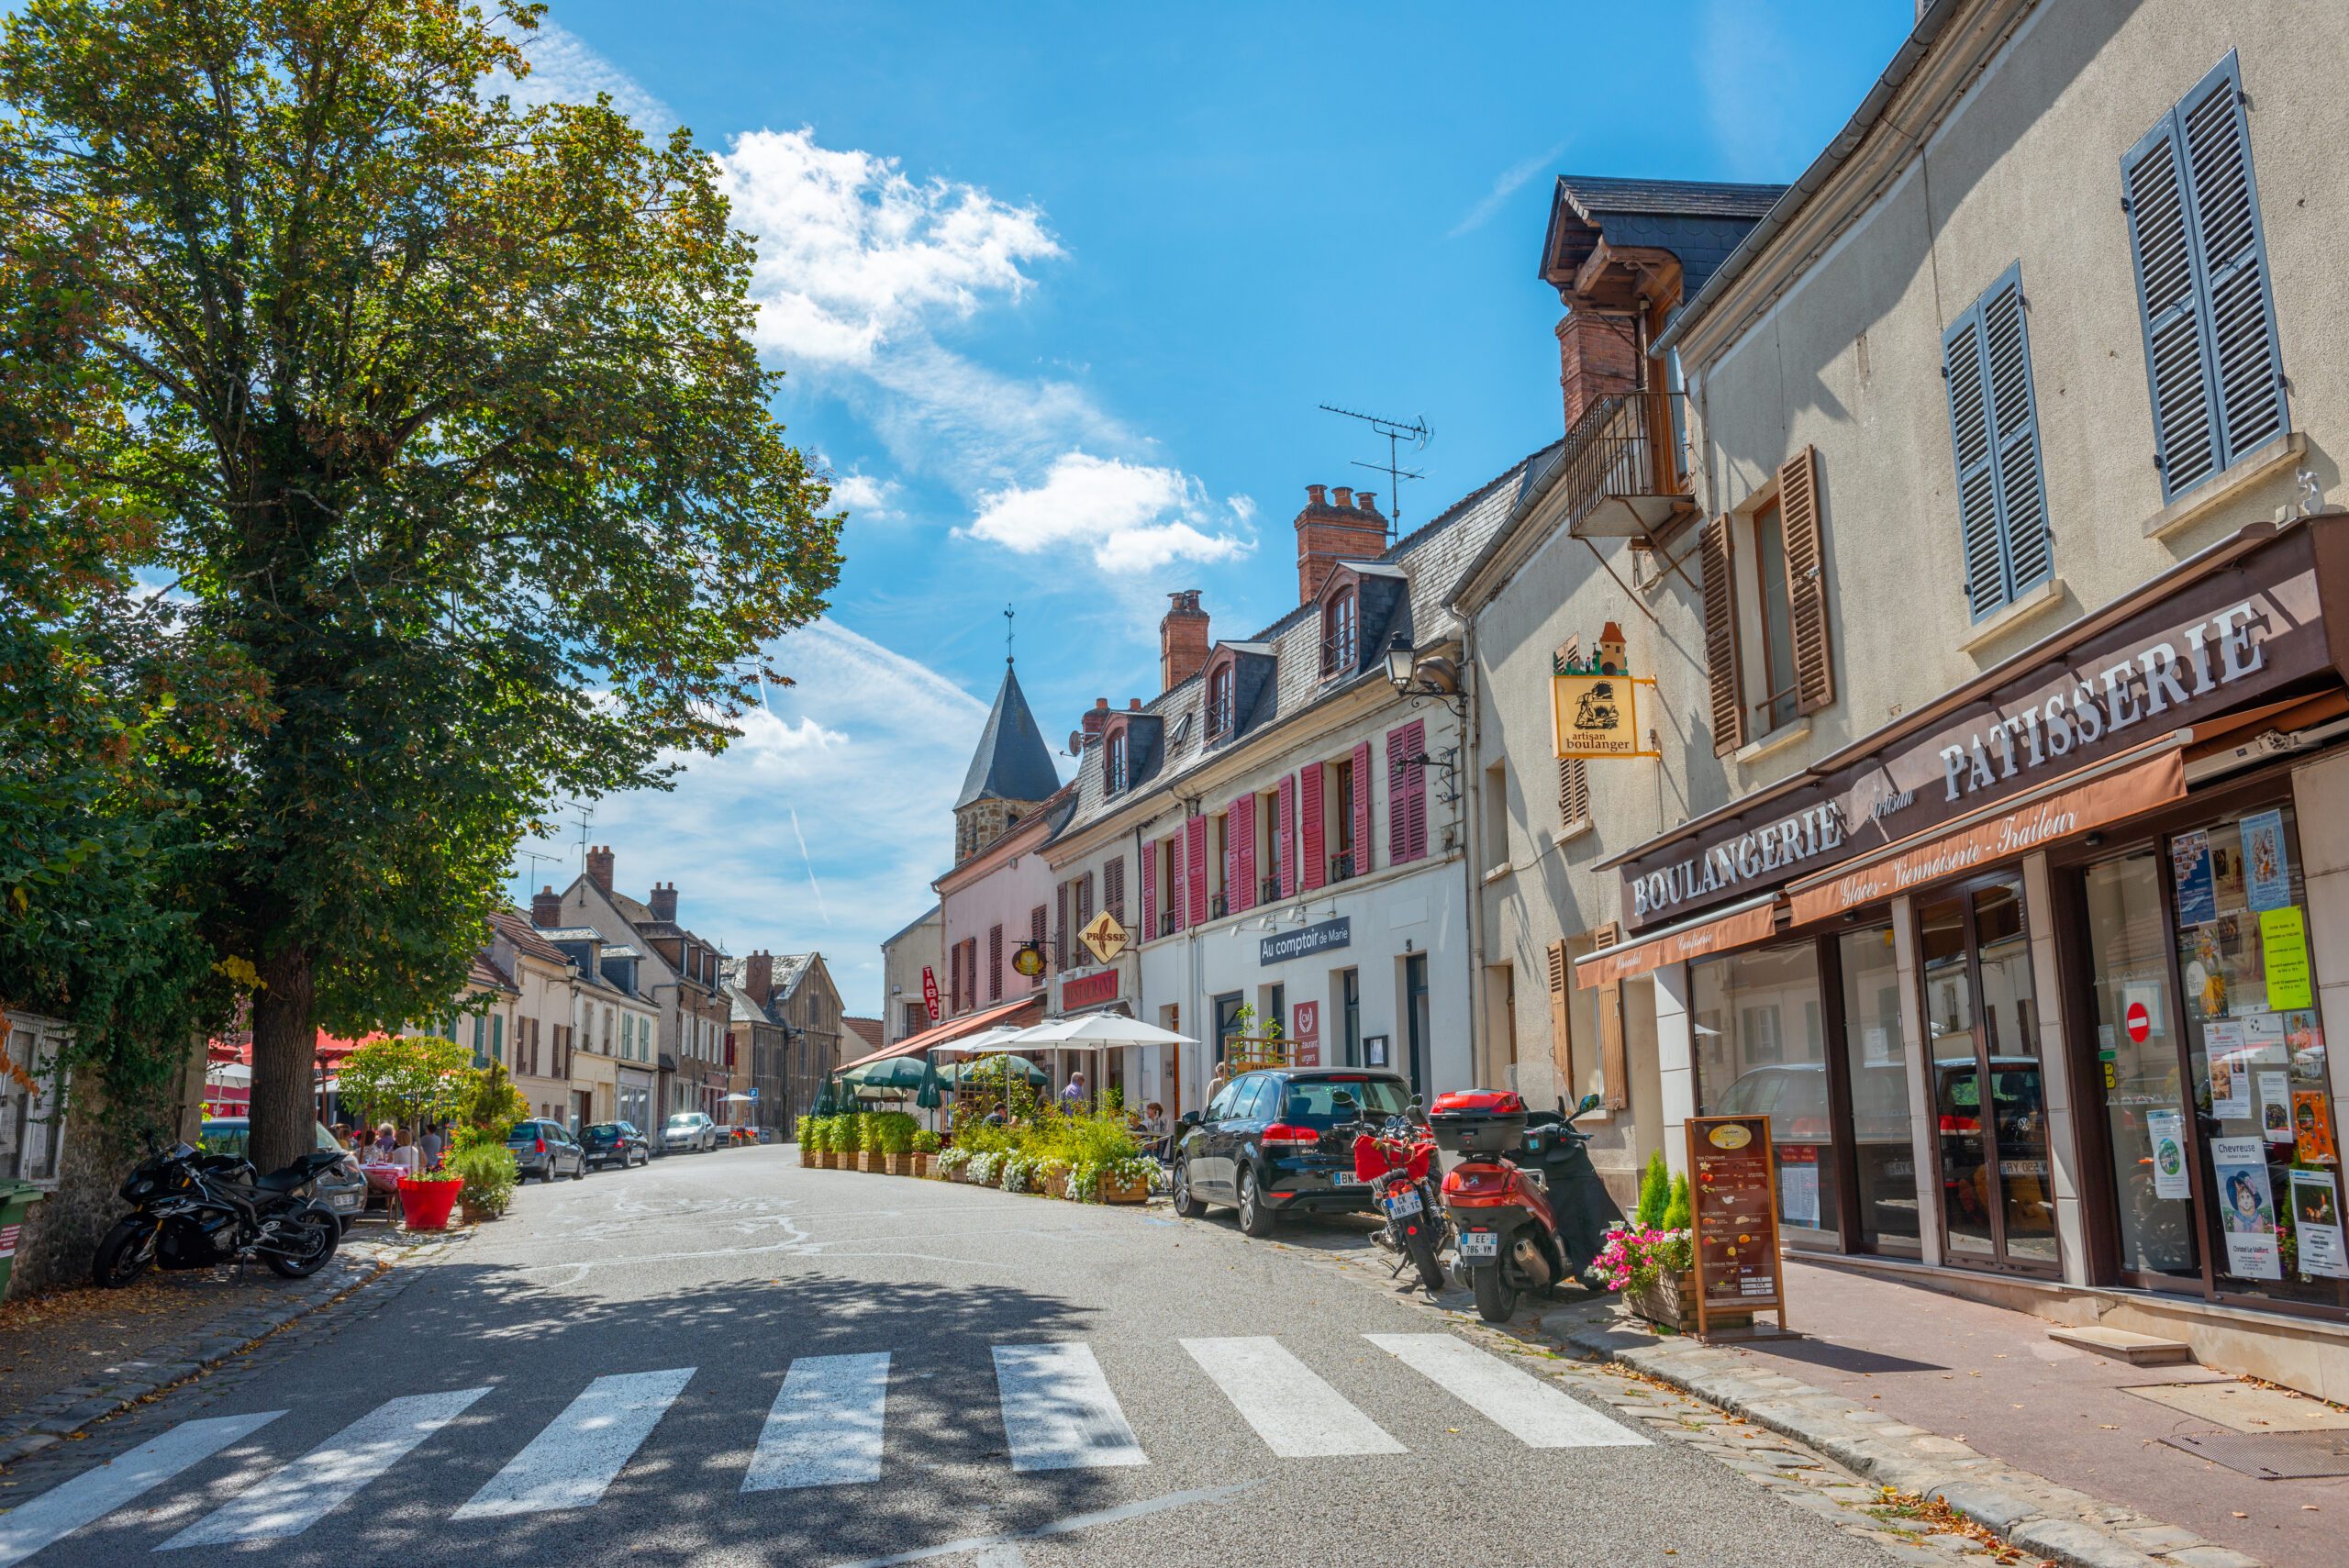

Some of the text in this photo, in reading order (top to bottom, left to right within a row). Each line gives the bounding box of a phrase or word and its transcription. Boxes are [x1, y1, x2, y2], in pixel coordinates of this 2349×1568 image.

[1939, 601, 2263, 803] PATISSERIE
[1566, 738, 1630, 751] boulanger
[1572, 731, 1606, 740] artisan
[1866, 786, 1915, 824] Artisan
[1632, 802, 1844, 917] BOULANGERIE
[1840, 876, 1879, 906] Glaces
[1891, 840, 1980, 889] Viennoiserie
[1997, 809, 2079, 854] Traiteur
[1085, 932, 1126, 942] PRESSE
[1262, 927, 1348, 960] Au comptoir de Marie
[924, 968, 939, 1018] TABAC
[1064, 975, 1113, 1006] RESTAURANT
[2218, 1143, 2255, 1153] Chevreuse
[1466, 1245, 1492, 1254] 786-VM
